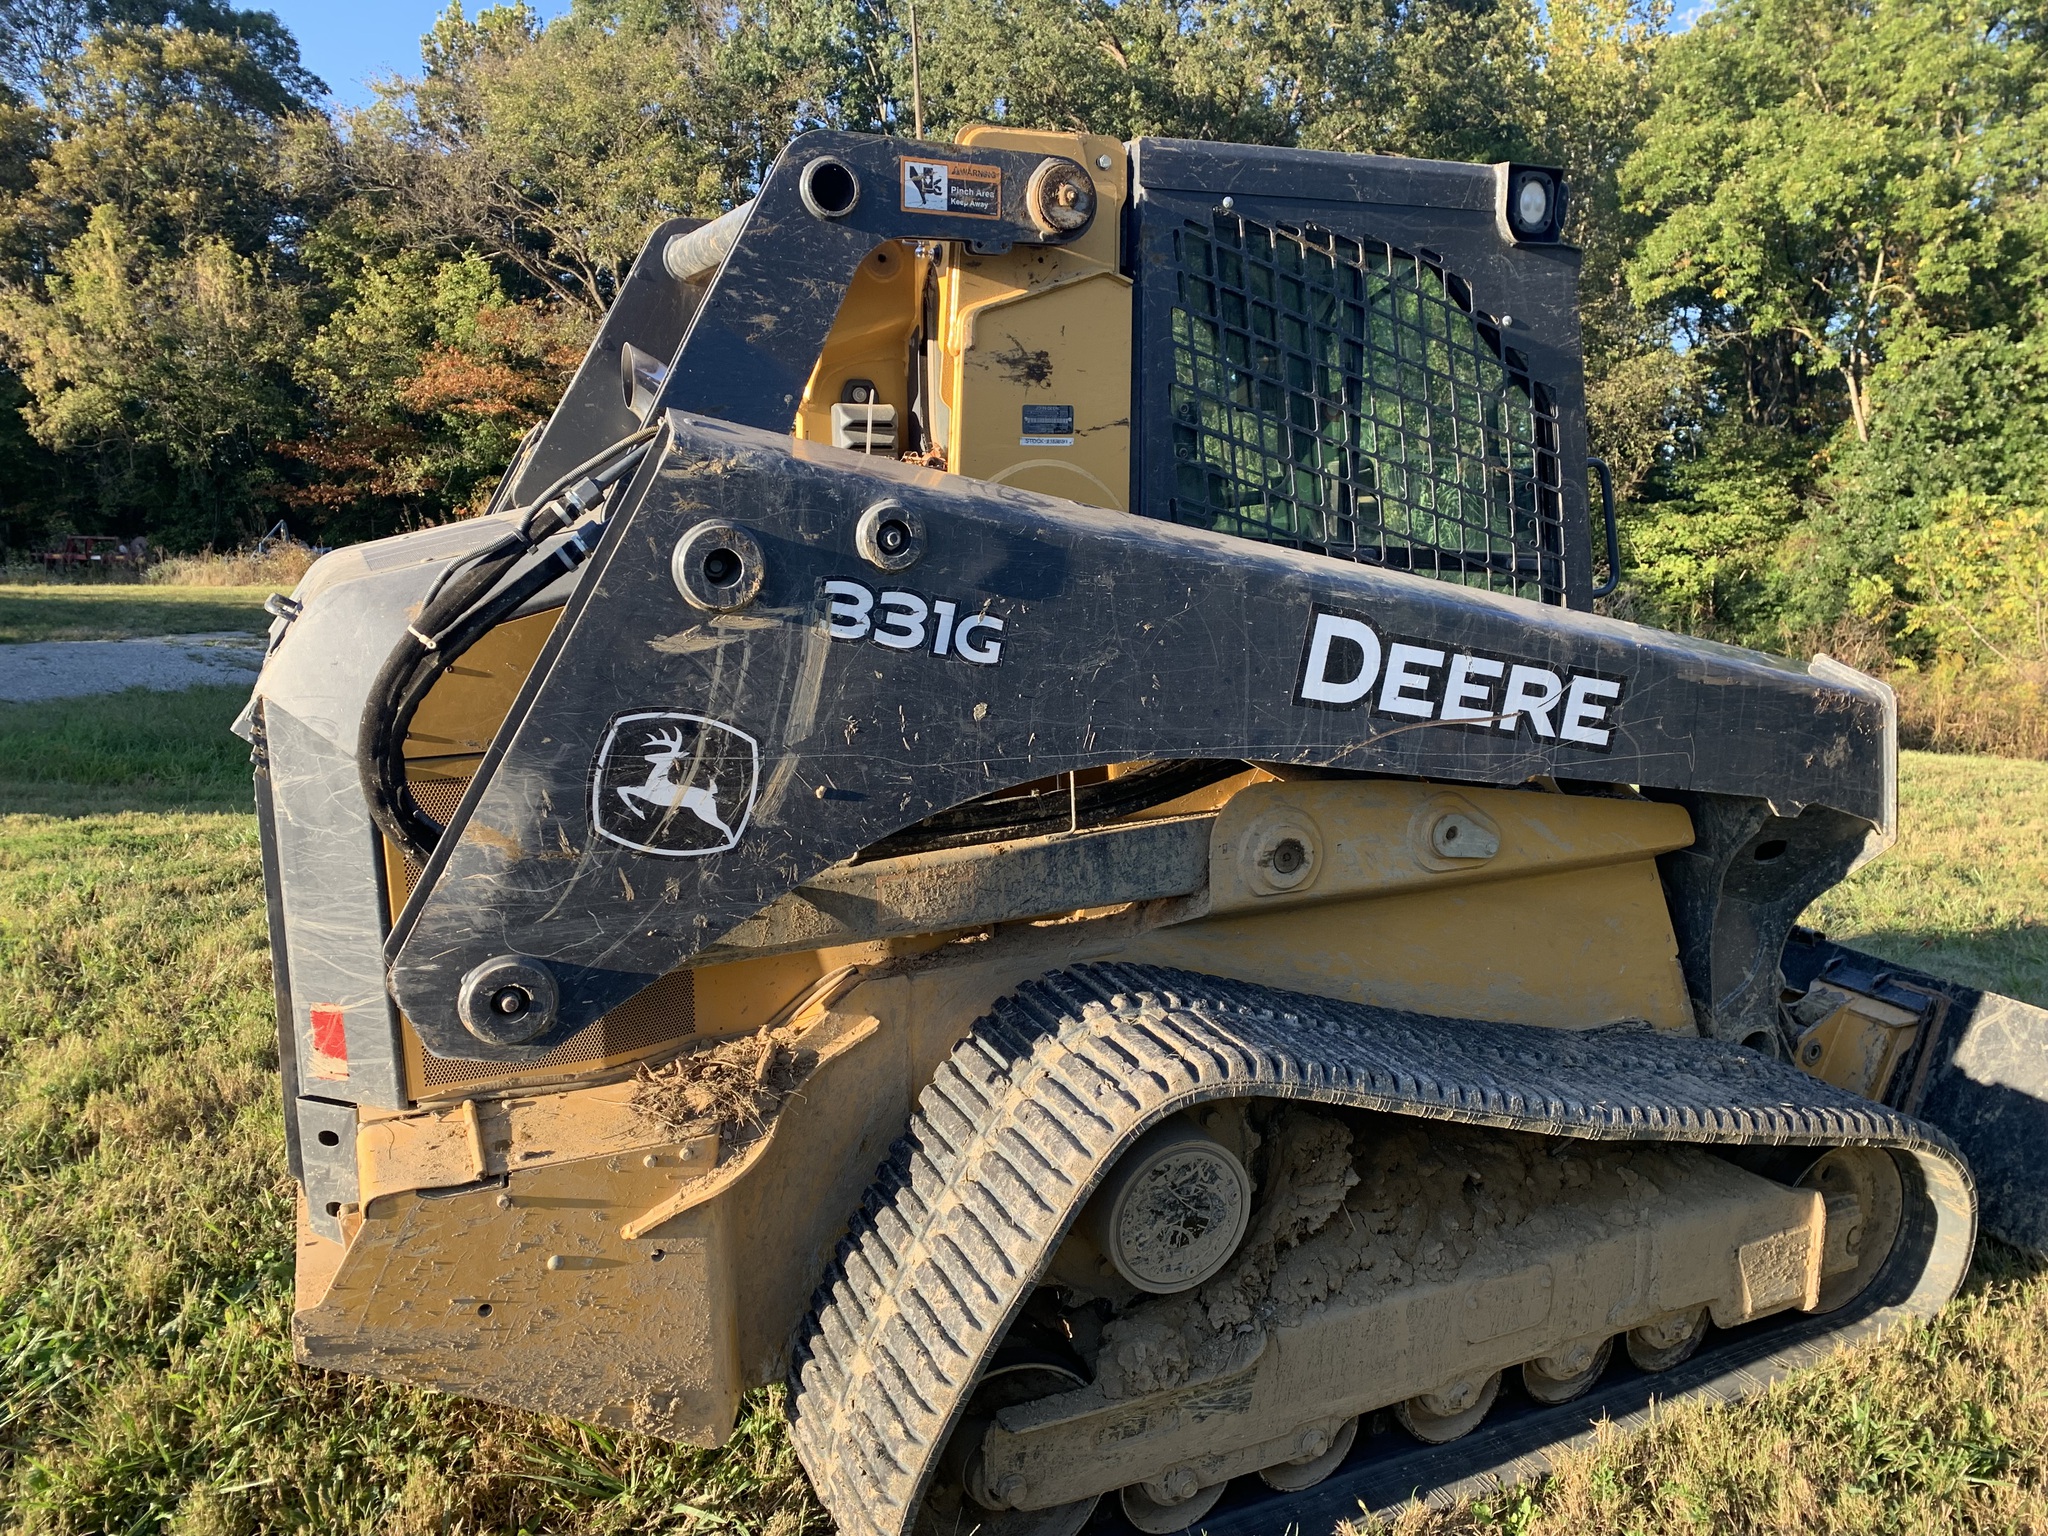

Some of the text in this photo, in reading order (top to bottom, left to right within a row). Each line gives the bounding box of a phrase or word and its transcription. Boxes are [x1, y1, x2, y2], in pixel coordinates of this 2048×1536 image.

[960, 167, 996, 179] WARNING
[951, 186, 995, 198] Pinch Area
[951, 197, 989, 210] Keep Away
[819, 580, 1005, 664] 331G
[1301, 613, 1620, 746] DEERE
